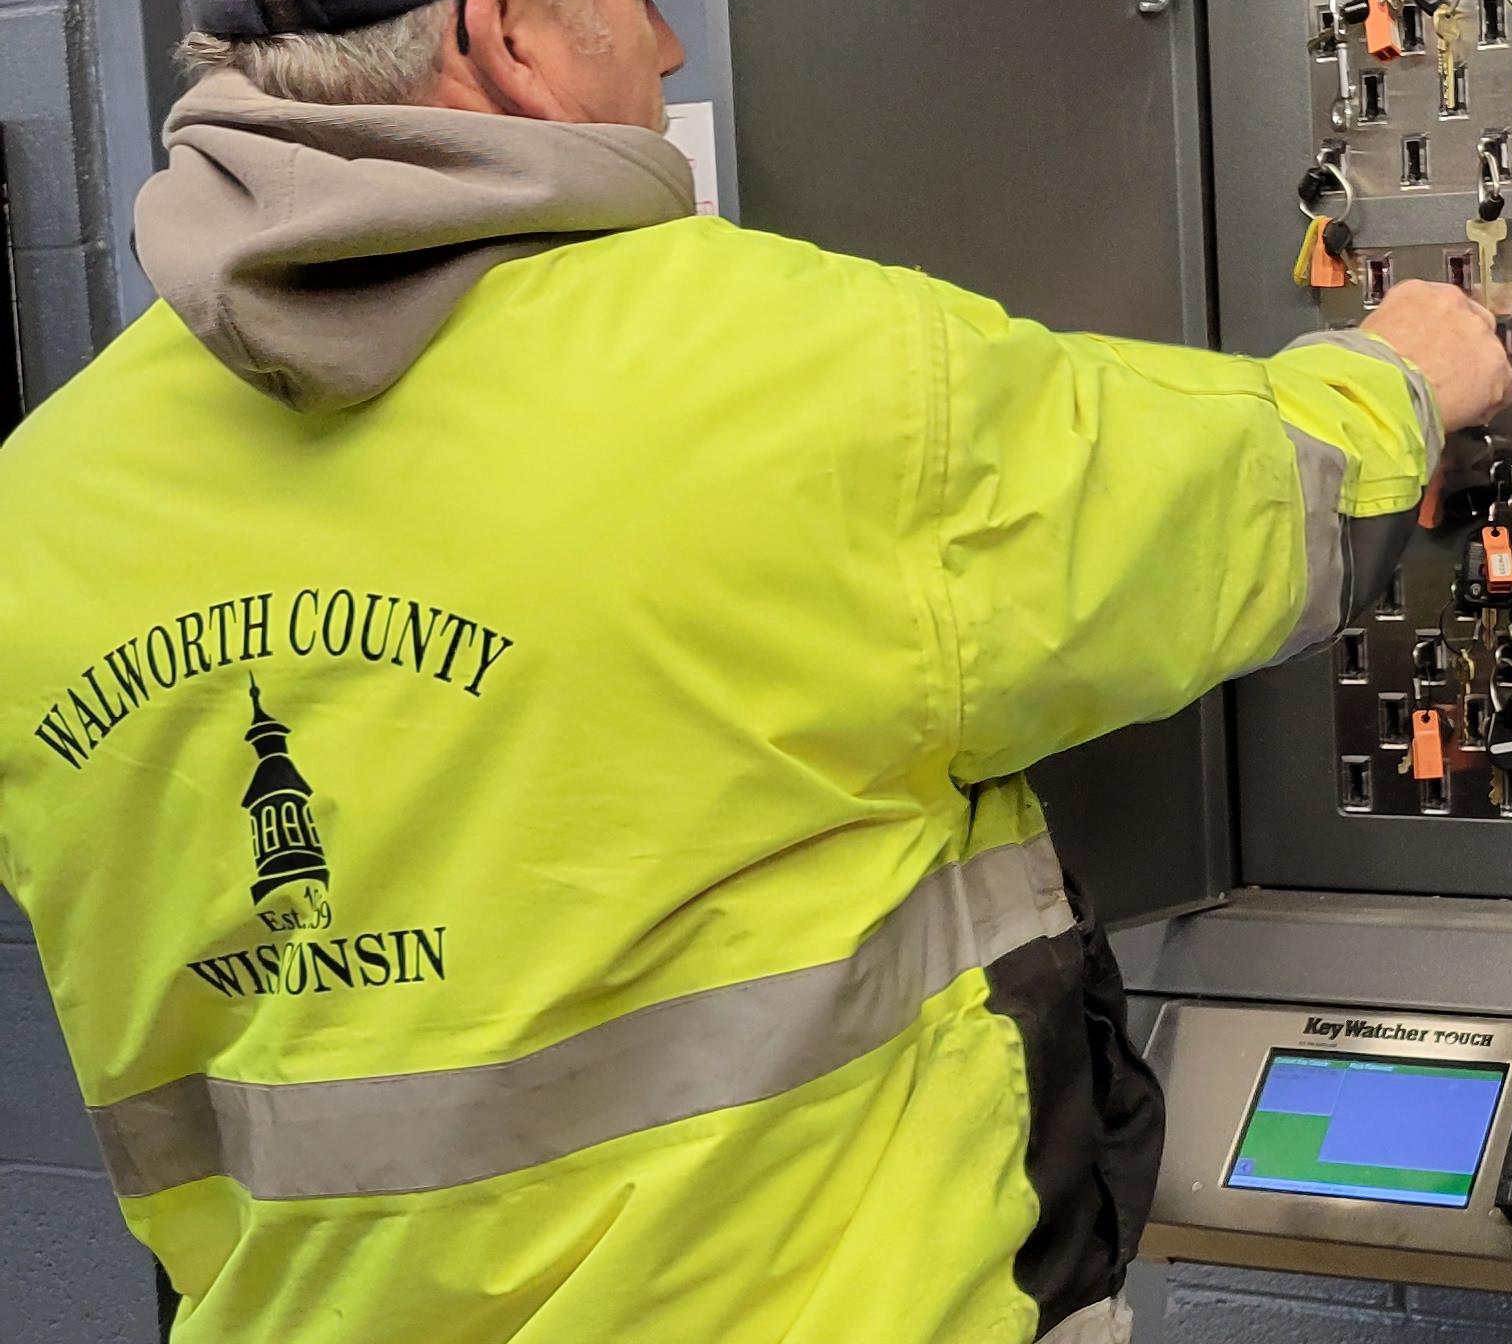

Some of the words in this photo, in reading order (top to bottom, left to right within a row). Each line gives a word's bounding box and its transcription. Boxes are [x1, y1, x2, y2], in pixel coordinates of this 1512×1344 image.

[34, 592, 273, 770] WALWORTH
[288, 588, 514, 698] COUNTY
[1433, 1030, 1495, 1047] TOUCH
